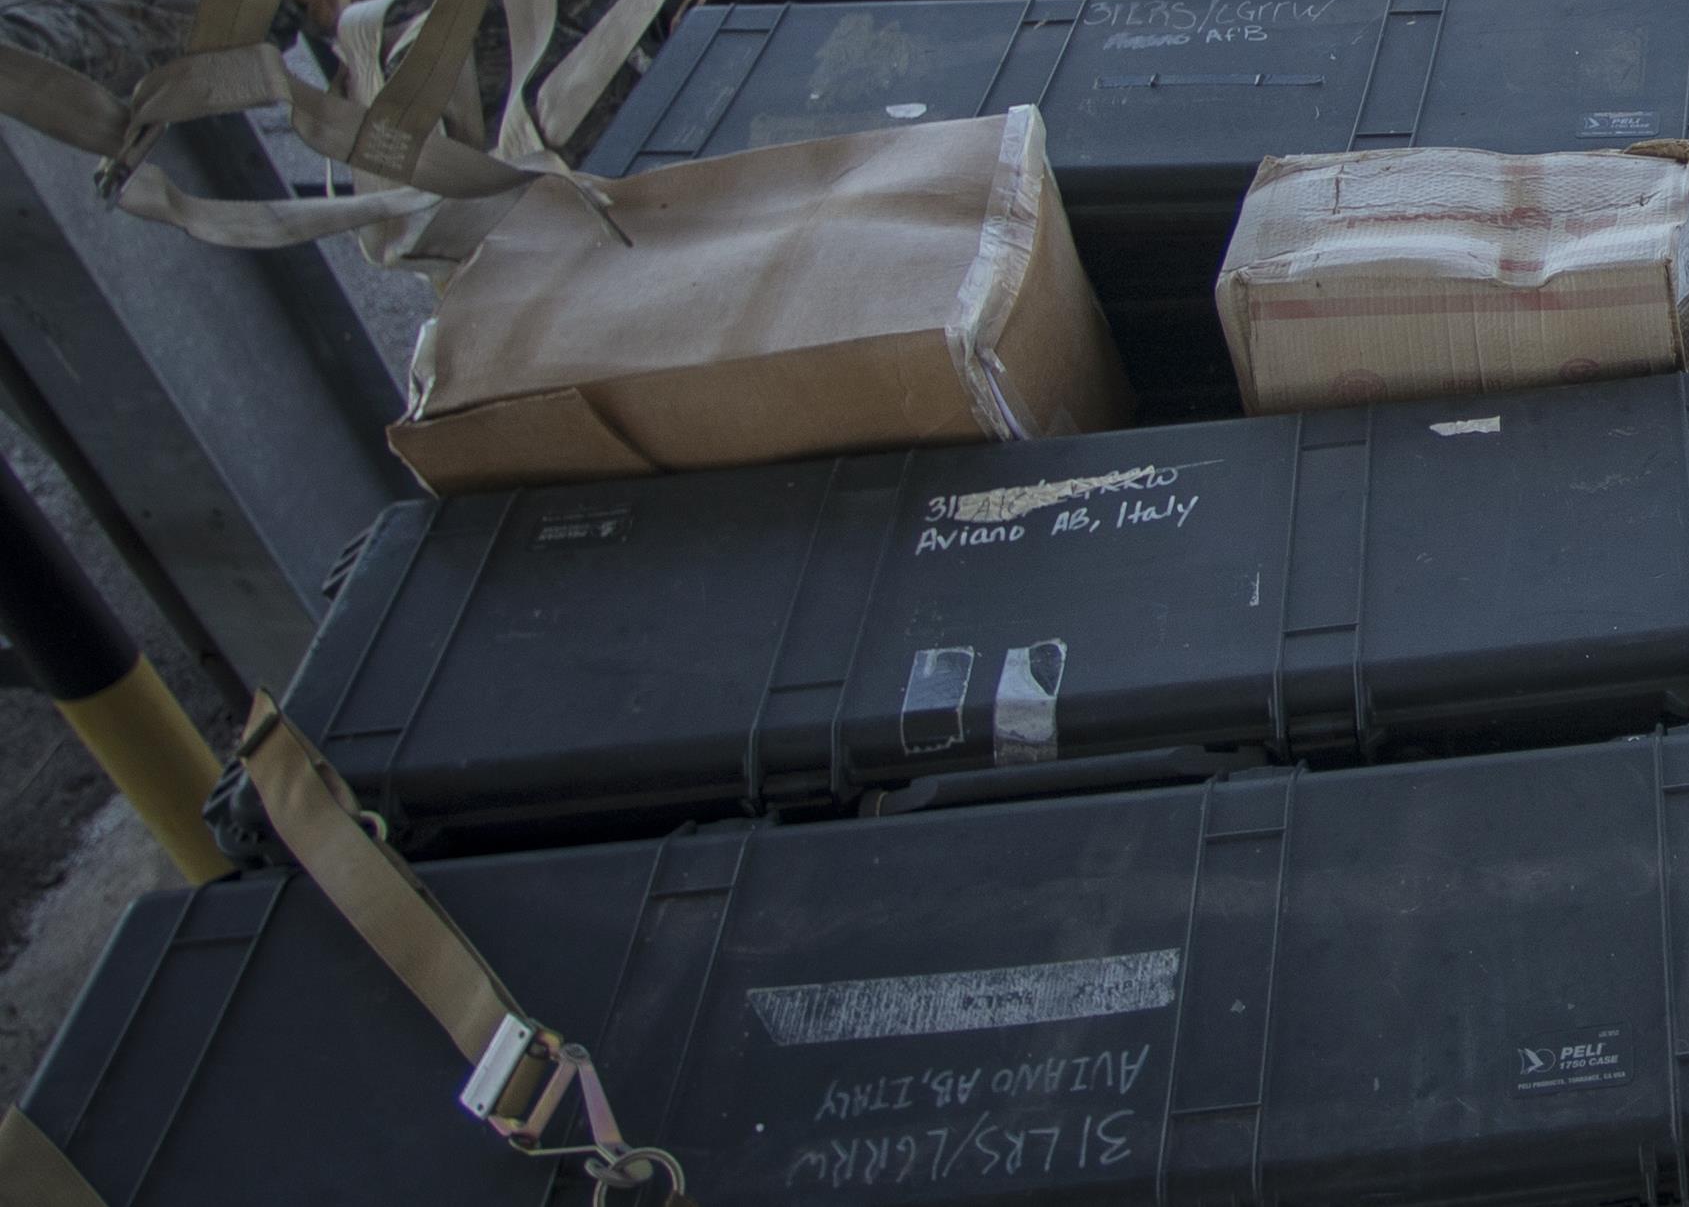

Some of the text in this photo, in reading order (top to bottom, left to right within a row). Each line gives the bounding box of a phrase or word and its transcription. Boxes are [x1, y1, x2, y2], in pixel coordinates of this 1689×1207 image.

[915, 495, 1200, 555] Aviano AB, Italy
[1560, 1043, 1603, 1060] PELI
[1588, 1055, 1619, 1066] CASE
[991, 1043, 1150, 1096] AVIANO
